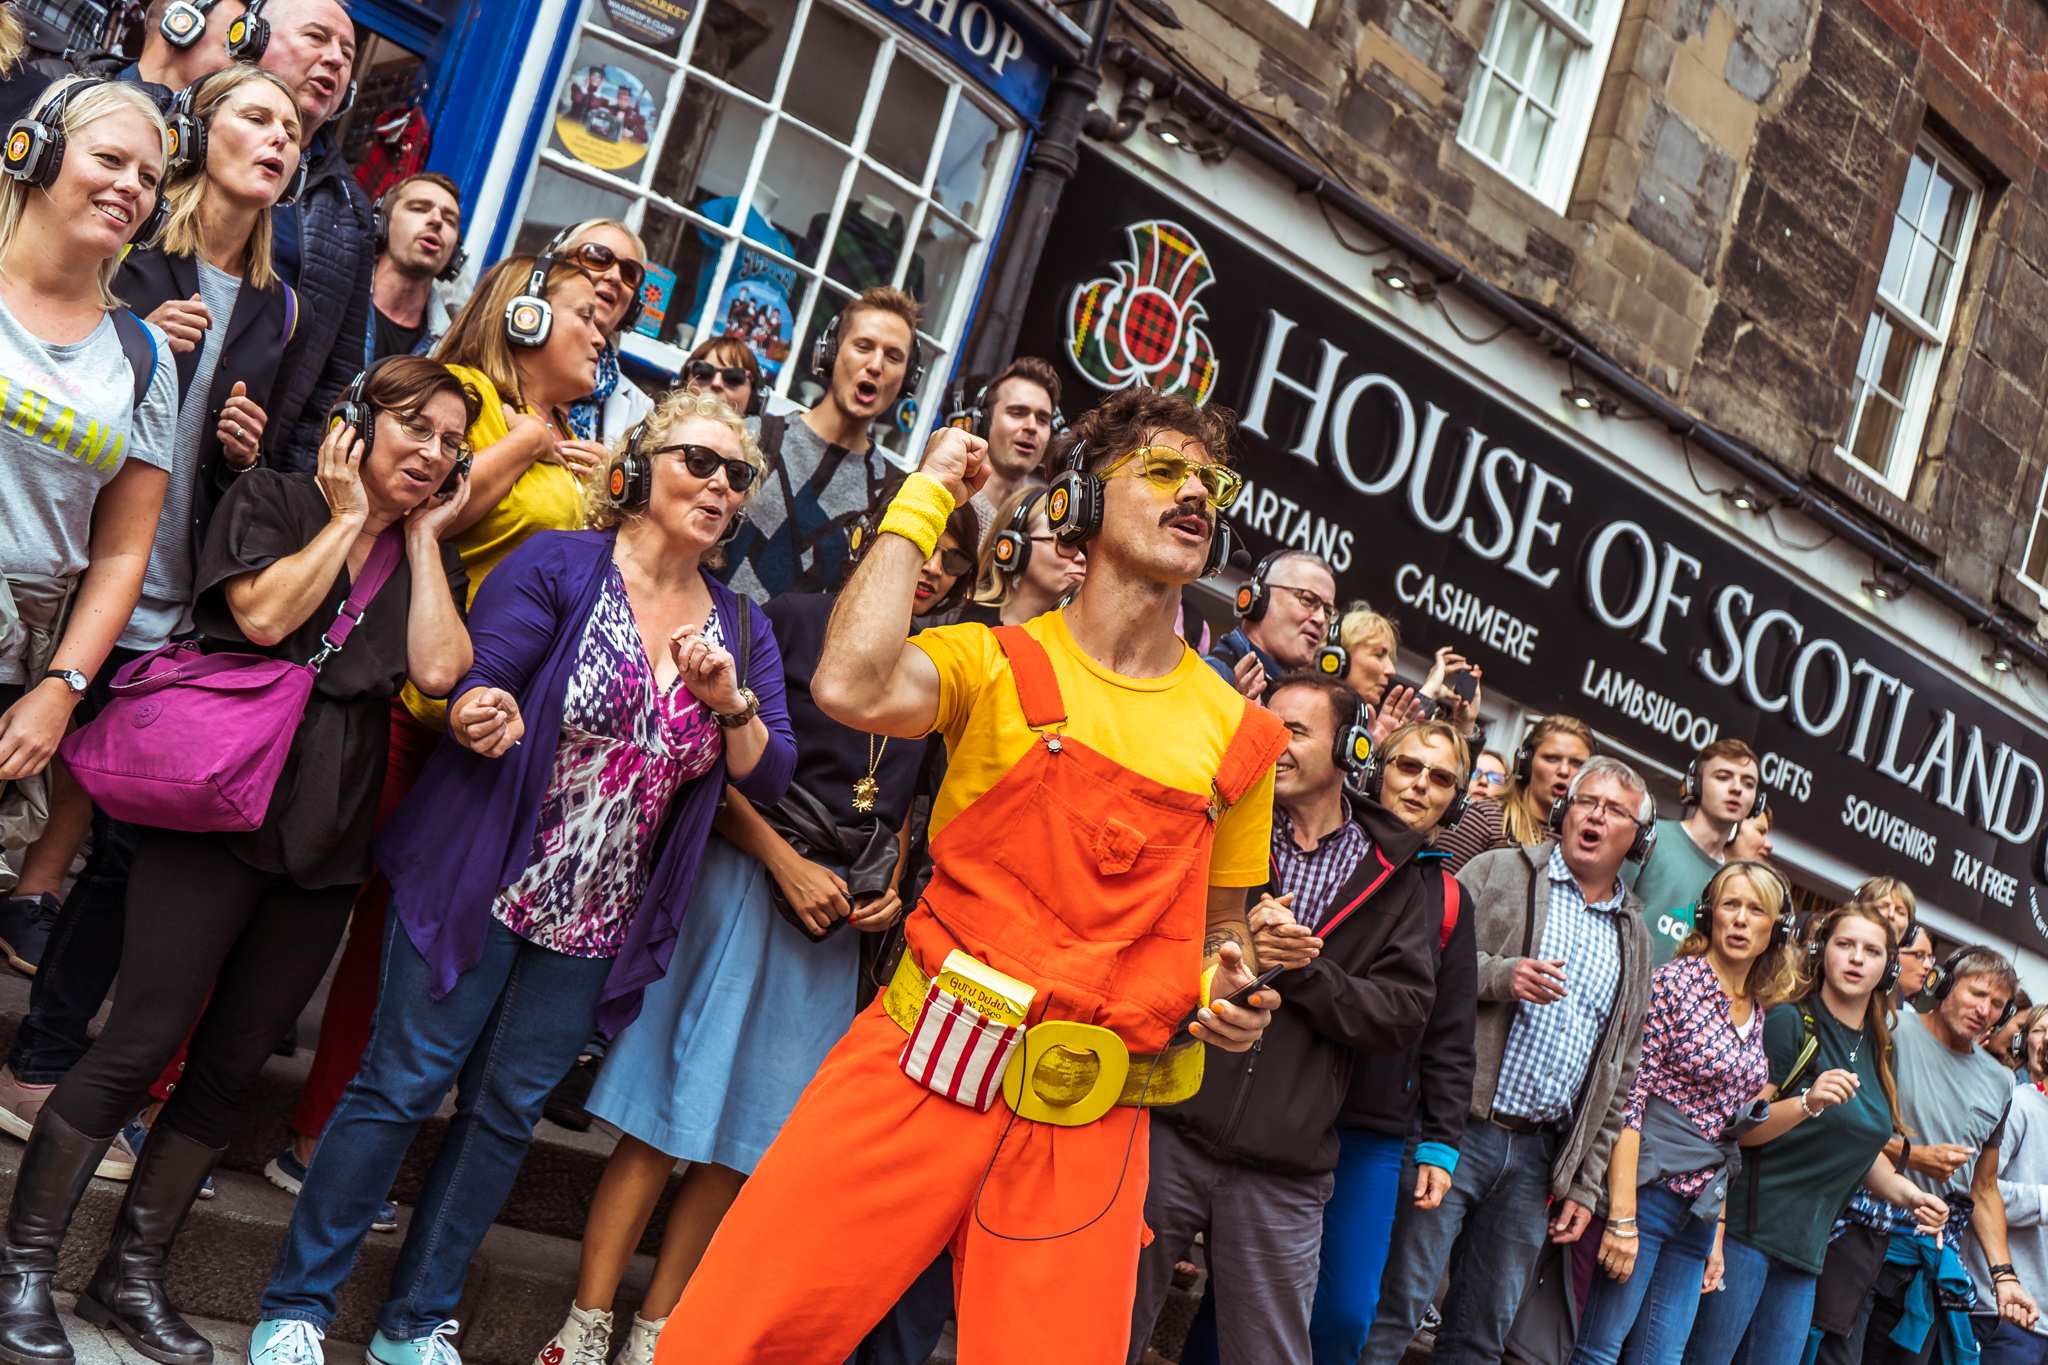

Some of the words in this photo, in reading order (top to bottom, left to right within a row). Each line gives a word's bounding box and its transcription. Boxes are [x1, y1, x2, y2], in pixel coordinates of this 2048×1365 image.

[893, 0, 1025, 76] HOP
[1238, 308, 1573, 589] HOUSE
[1587, 520, 1702, 655] OF
[1700, 585, 2046, 845] SCOTLAND
[1395, 564, 1539, 665] CASHMERE
[1760, 751, 1814, 802] GIFTS
[1841, 795, 1937, 867] SOUVENIRS
[1951, 849, 1983, 890] TAX
[1980, 864, 2018, 907] FREE
